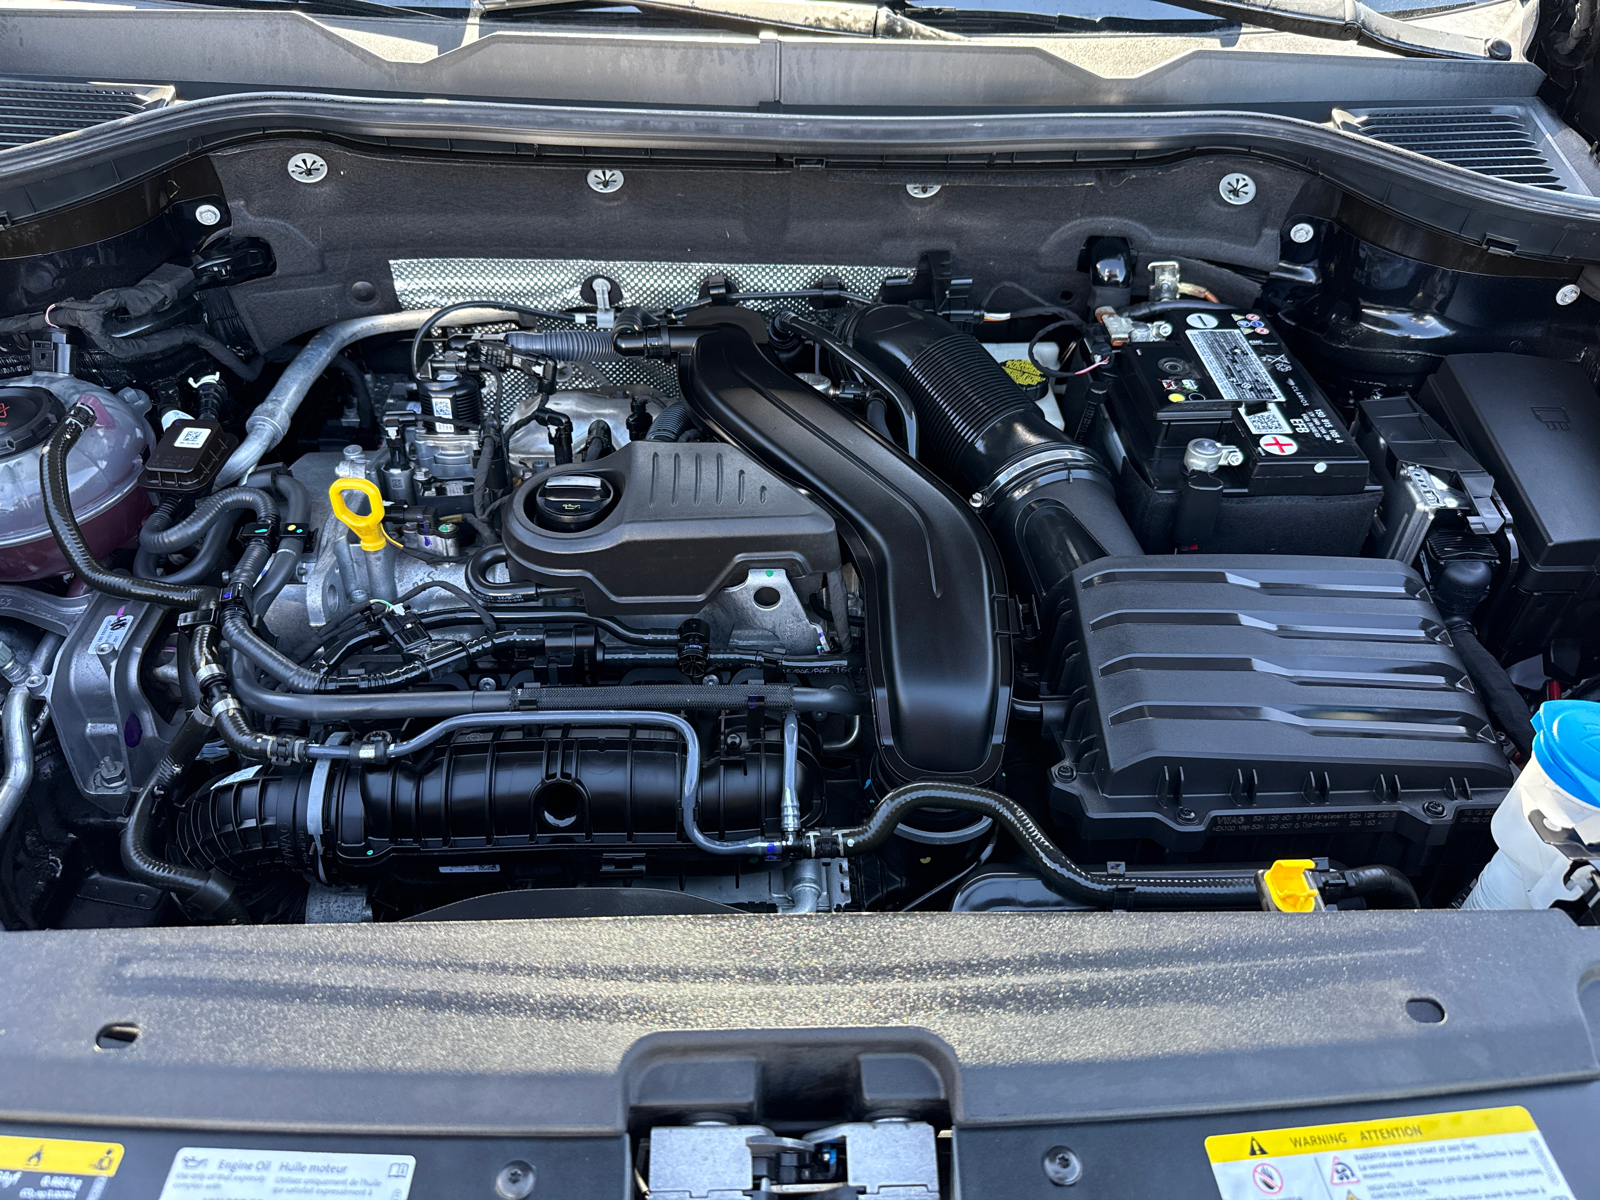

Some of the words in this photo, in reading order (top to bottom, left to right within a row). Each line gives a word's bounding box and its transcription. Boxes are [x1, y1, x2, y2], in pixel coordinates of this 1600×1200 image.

[1291, 386, 1310, 407] CLARIOS
[1290, 418, 1310, 433] EFB
[1216, 816, 1244, 824] VWAG
[1289, 1132, 1348, 1148] WARNING
[1360, 1125, 1424, 1141] ATTENTION
[218, 1159, 254, 1172] Engine
[256, 1160, 272, 1171] Oil
[279, 1162, 307, 1172] Huile
[309, 1163, 348, 1174] moteur
